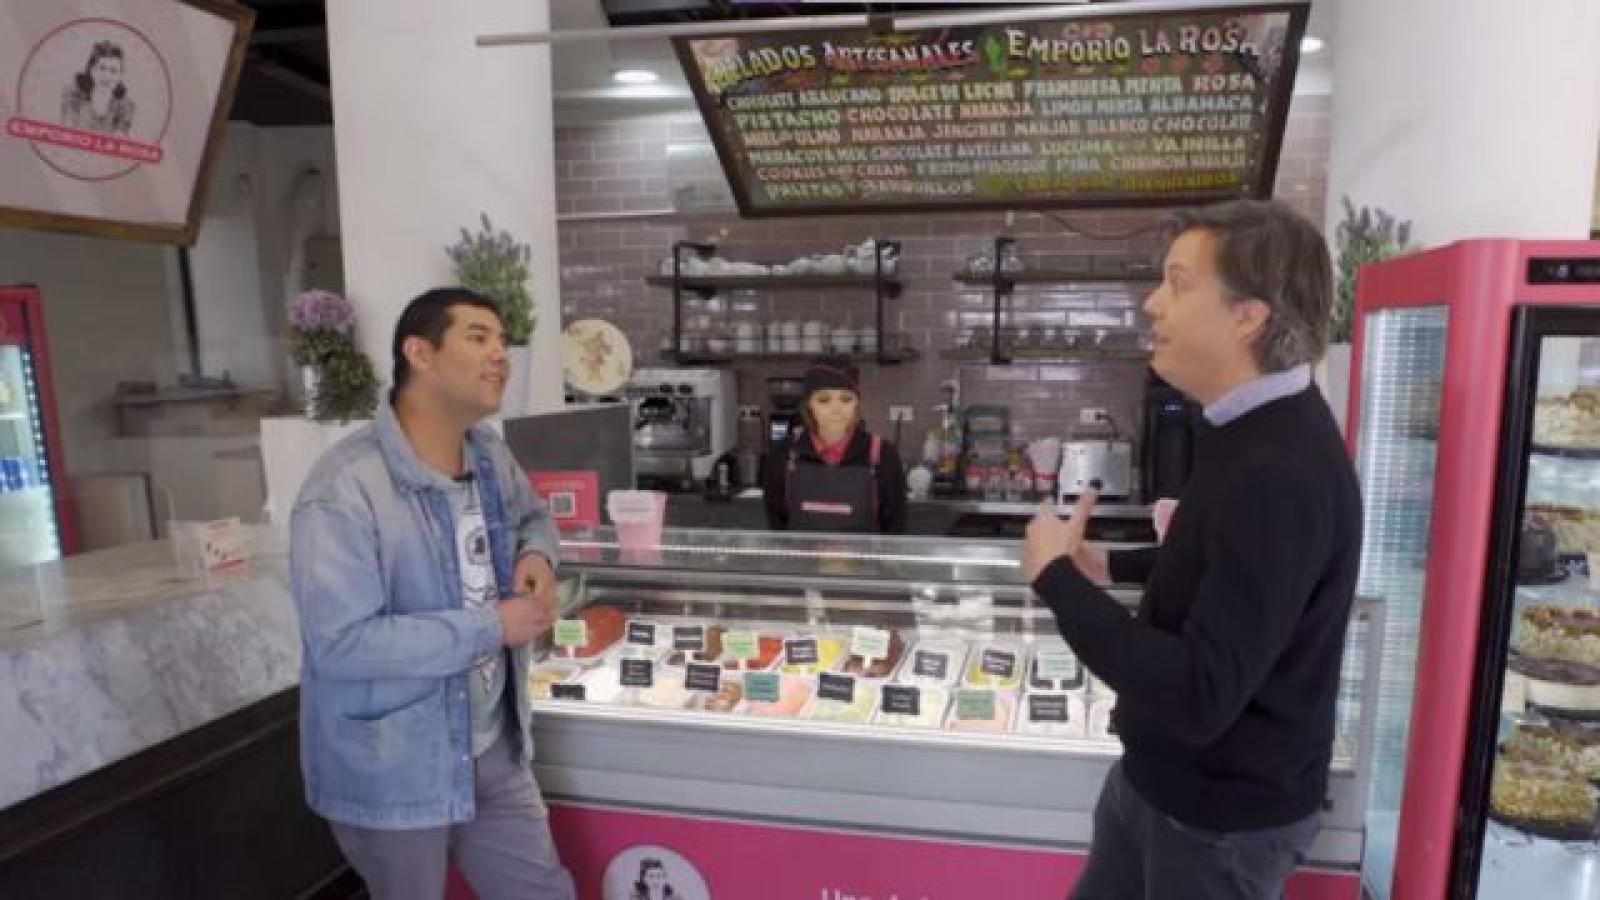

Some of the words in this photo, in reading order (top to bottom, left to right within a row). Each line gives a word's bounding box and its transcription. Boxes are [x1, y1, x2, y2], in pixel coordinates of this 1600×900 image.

[1007, 29, 1130, 64] EMPORIO
[1139, 29, 1171, 54] LA
[1192, 73, 1256, 92] ROSA
[735, 108, 841, 129] PISTACHO
[846, 103, 953, 122] CHOCOLATE
